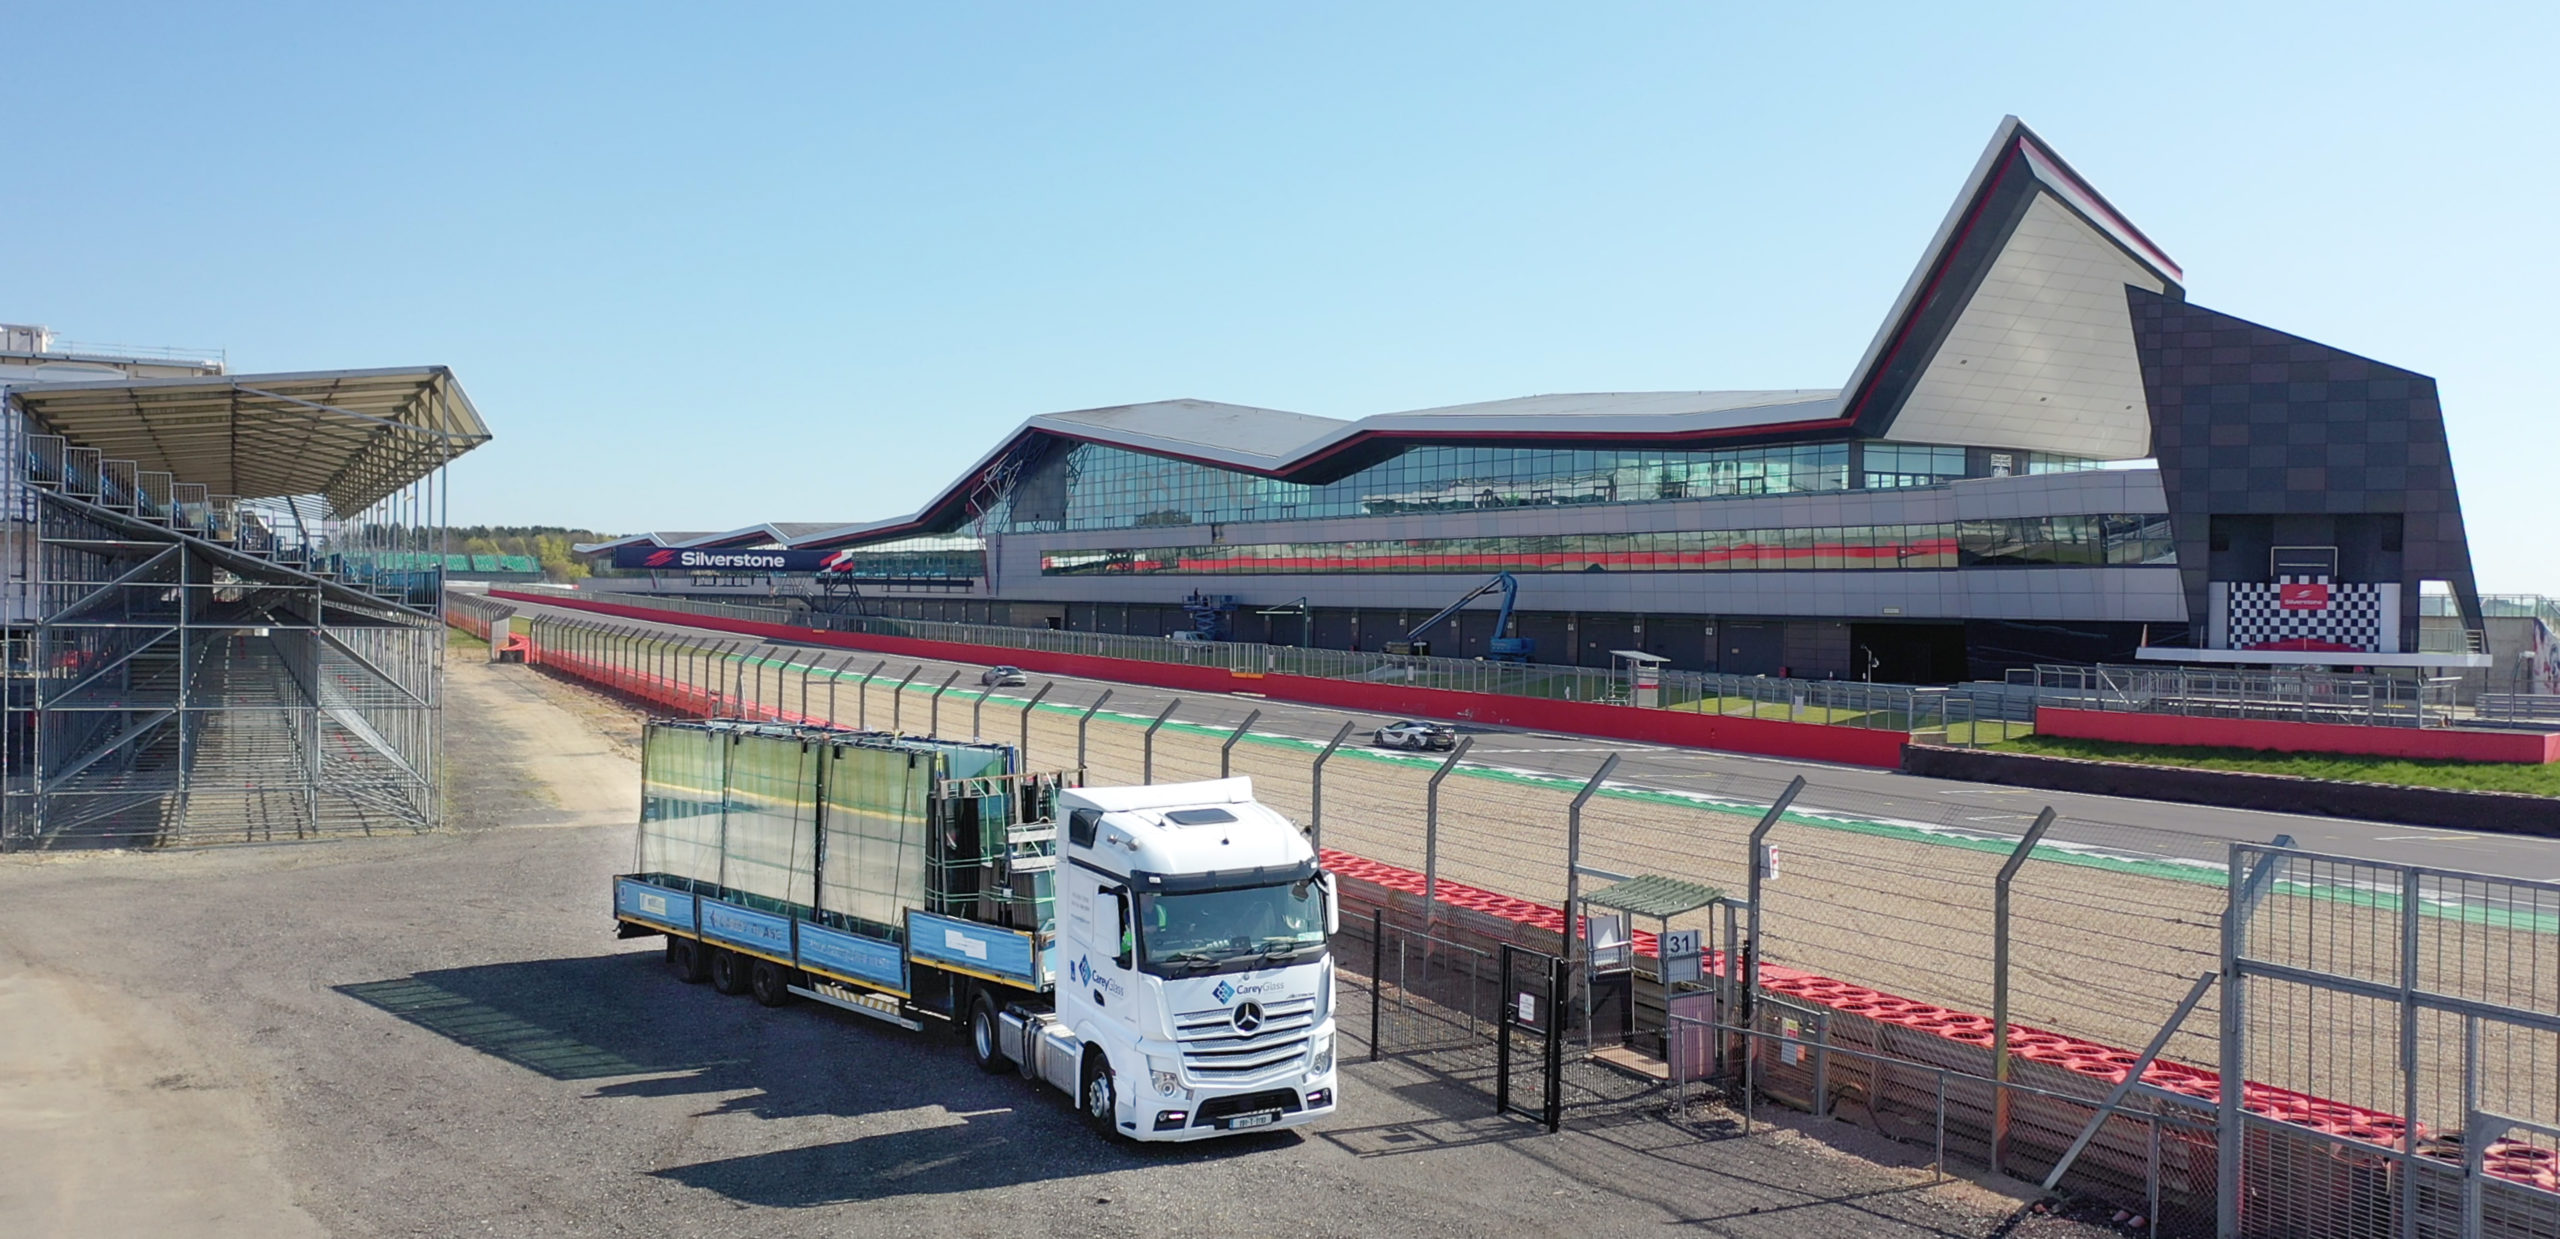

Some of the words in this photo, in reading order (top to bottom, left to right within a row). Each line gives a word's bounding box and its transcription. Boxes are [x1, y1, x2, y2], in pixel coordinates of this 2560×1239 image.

[681, 551, 785, 568] Silverstone
[1670, 934, 1689, 953] 31
[1092, 969, 1124, 997] CareyGlass
[1237, 981, 1285, 995] CareyGlass
